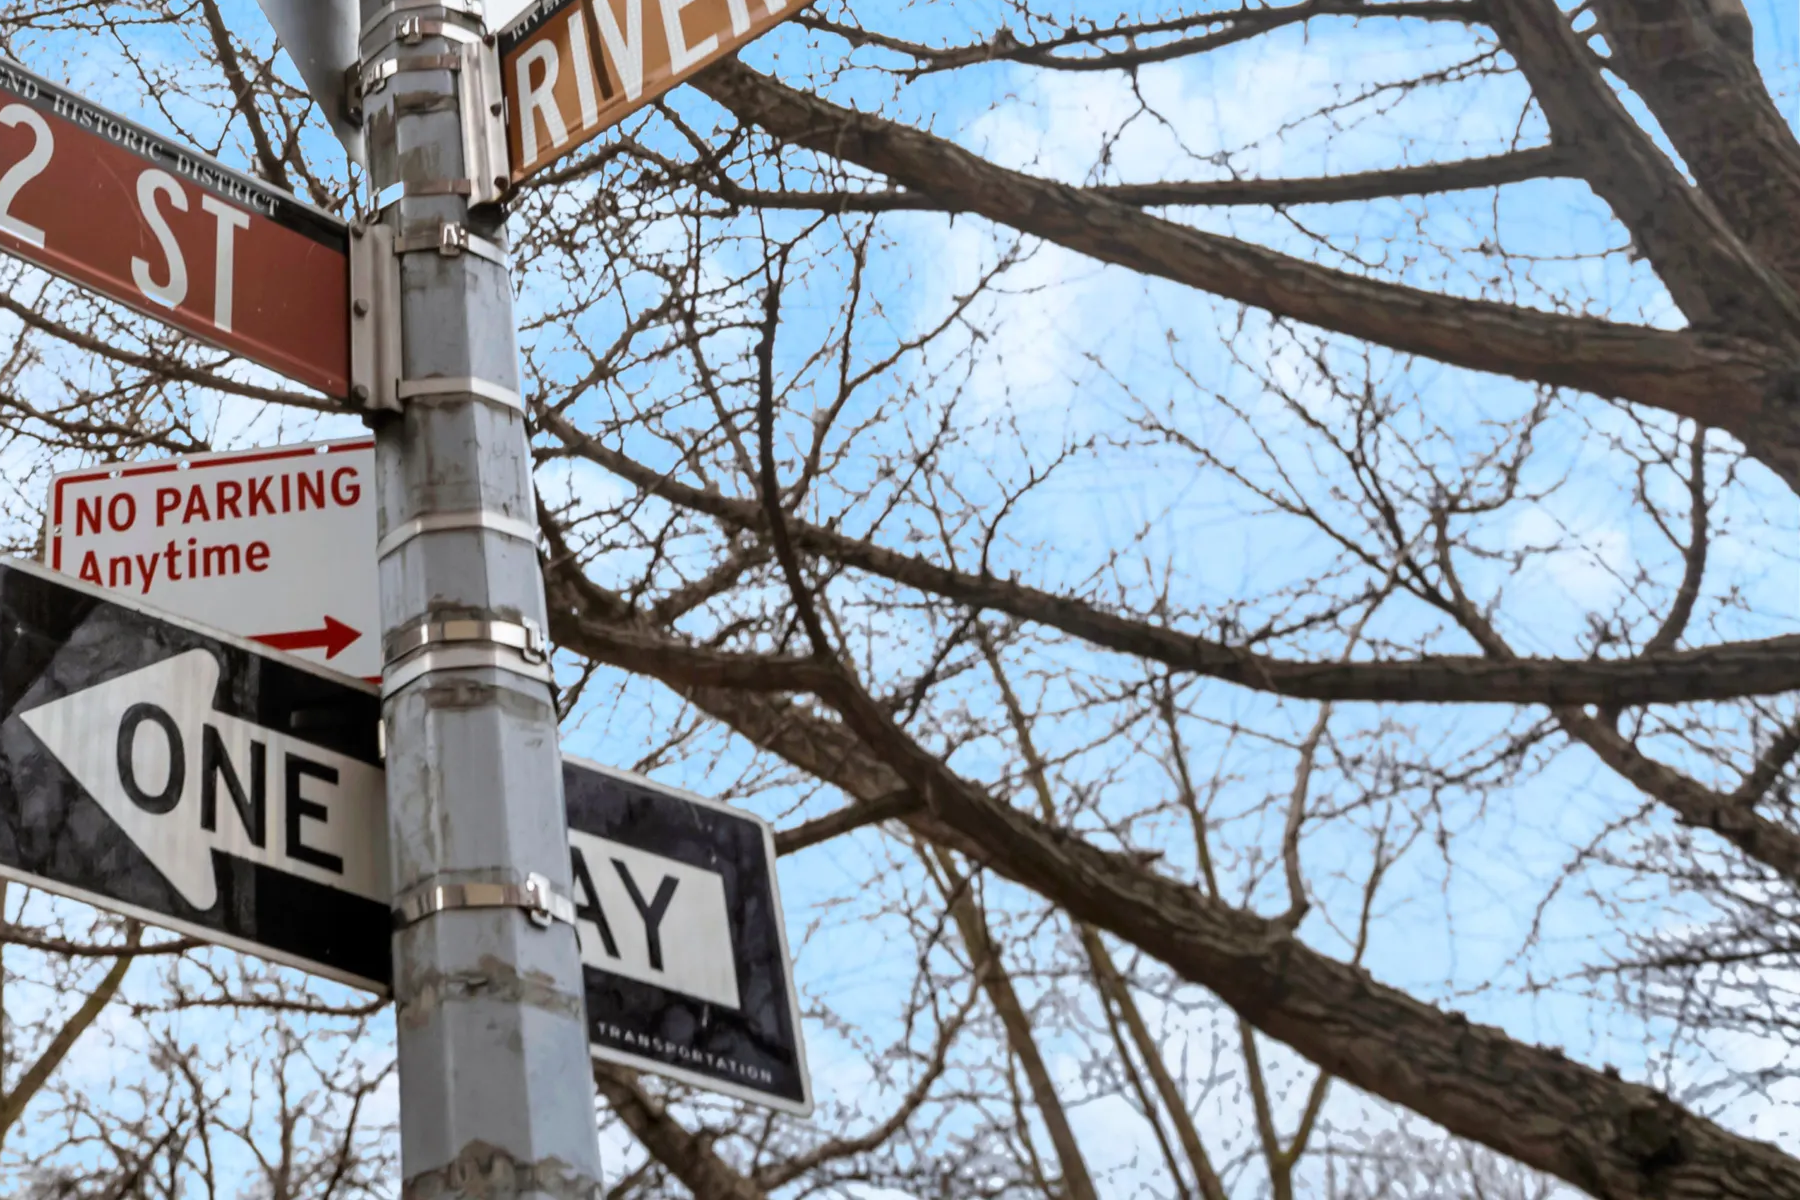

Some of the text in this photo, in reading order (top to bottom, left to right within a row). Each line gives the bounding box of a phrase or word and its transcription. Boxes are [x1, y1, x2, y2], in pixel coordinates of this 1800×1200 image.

[53, 94, 163, 161] HISTORIC
[176, 152, 280, 217] DISTRICT
[131, 169, 250, 333] ST
[75, 466, 361, 536] NO PARKING
[78, 537, 271, 594] Anytime
[116, 701, 680, 974] ONE AY
[596, 1022, 773, 1084] TRANSPORTATION
